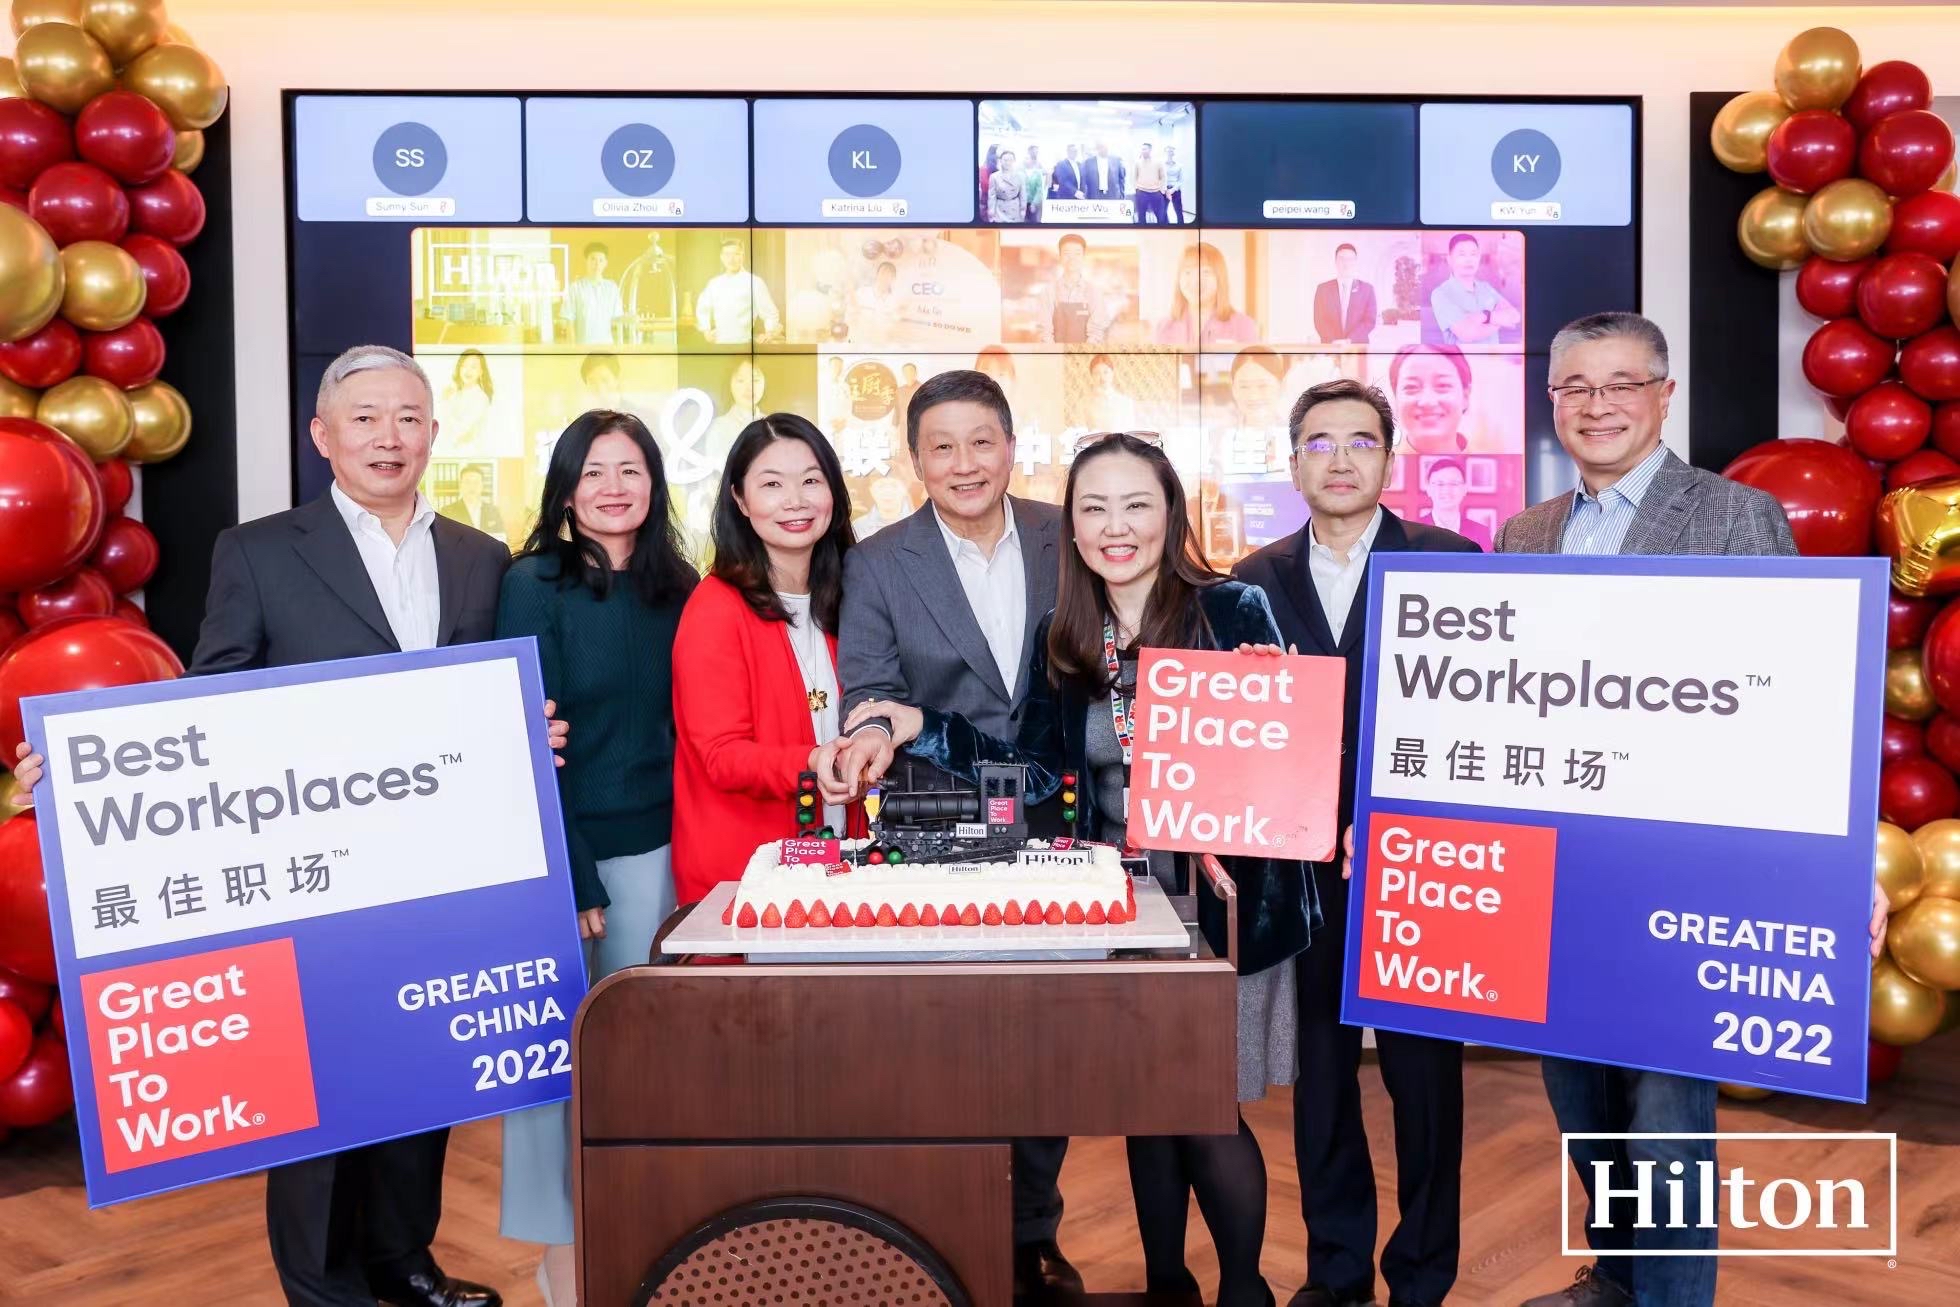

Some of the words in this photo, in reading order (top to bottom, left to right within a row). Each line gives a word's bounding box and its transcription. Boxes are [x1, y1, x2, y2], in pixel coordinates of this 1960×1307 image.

[395, 149, 425, 167] SS
[623, 150, 653, 168] OZ
[852, 151, 877, 169] KL
[1513, 155, 1540, 172] KY
[602, 202, 630, 212] Olivia
[633, 202, 658, 212] Zhou
[831, 203, 865, 212] Katrina
[868, 203, 882, 212] Liu
[1051, 203, 1089, 213] Heather
[1397, 593, 1516, 642] Best
[1148, 659, 1293, 704] Great
[1148, 704, 1289, 750] Place
[68, 724, 210, 785] Best
[1142, 753, 1196, 791] To
[959, 826, 984, 835] Hilton
[1379, 826, 1505, 873] Great
[1379, 868, 1502, 914] Place
[1375, 910, 1420, 947] To
[1648, 909, 1836, 960] GREATER
[98, 965, 247, 1021] Great
[397, 957, 560, 1012] GREATER
[1697, 960, 1835, 1006] CHINA
[108, 1013, 250, 1064] Place
[449, 999, 565, 1043] CHINA
[1712, 1012, 1833, 1065] 2022
[472, 1038, 572, 1092] 2022
[109, 1069, 168, 1108] To
